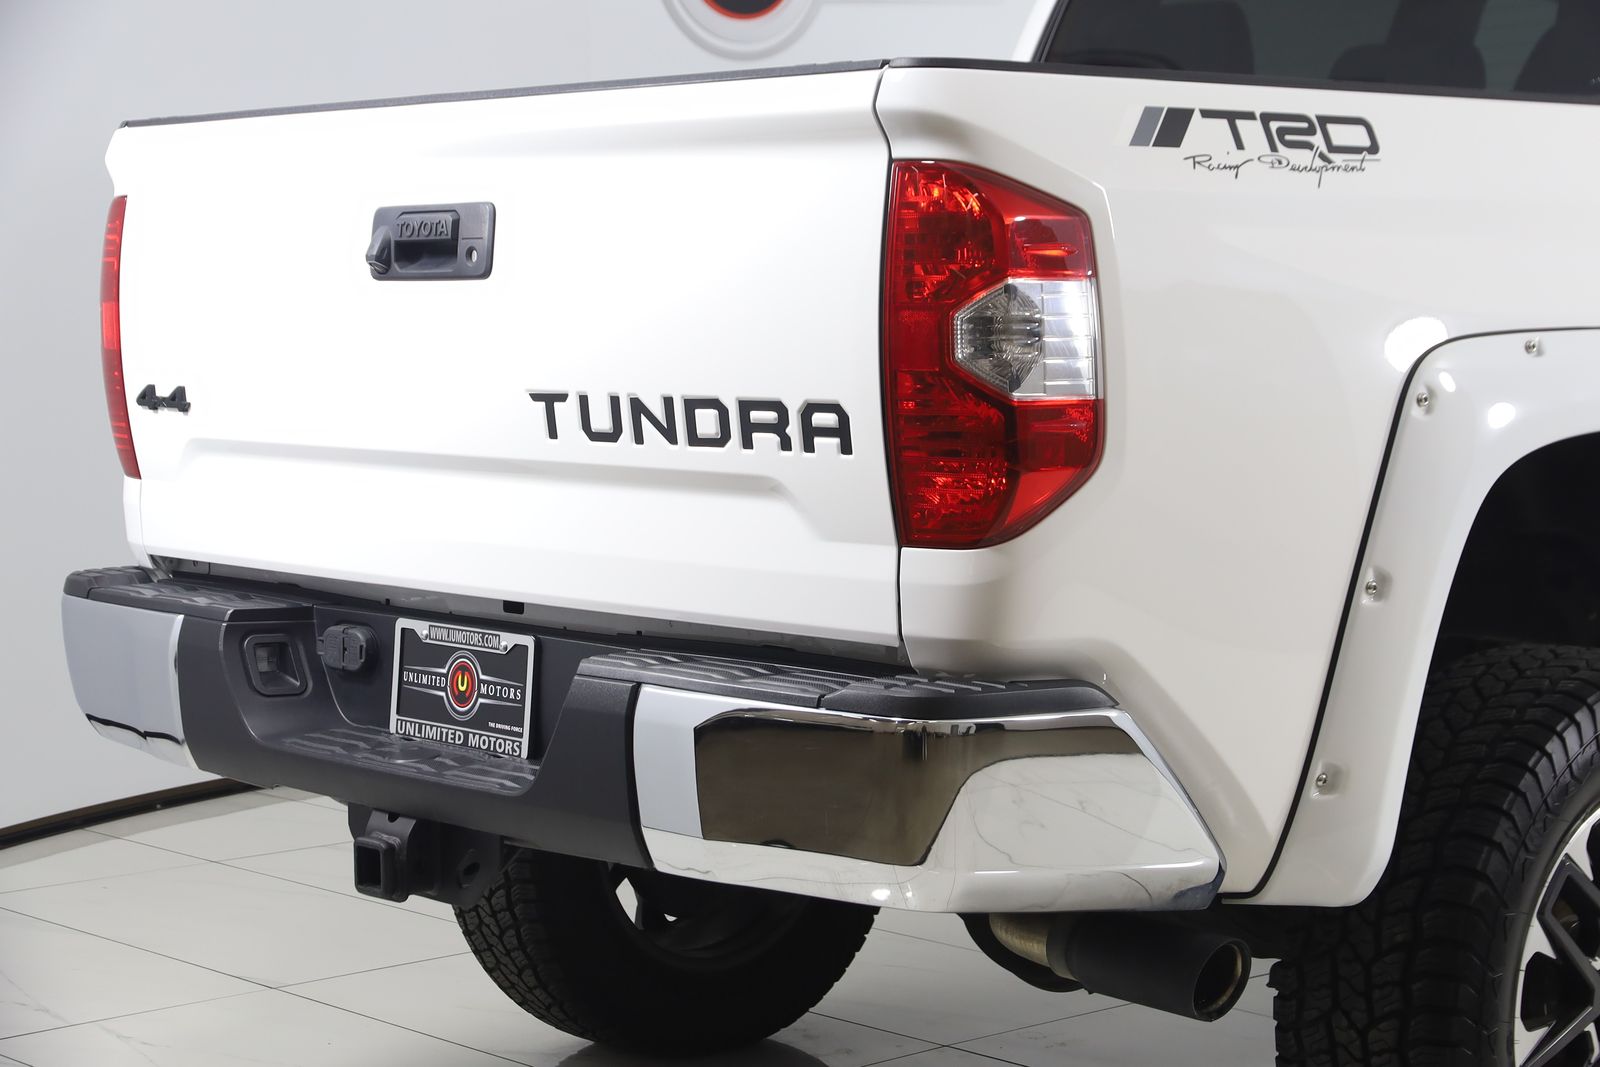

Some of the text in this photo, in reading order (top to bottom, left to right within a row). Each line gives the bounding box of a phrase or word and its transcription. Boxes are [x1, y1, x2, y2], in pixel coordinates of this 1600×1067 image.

[1199, 108, 1380, 163] TRD
[1184, 152, 1254, 179] Racing
[396, 219, 448, 238] TOYOTA
[527, 391, 853, 455] TUNDRA
[429, 626, 500, 649] WWW.IUMOTORS.COM
[403, 671, 522, 700] UNLIMITED MOTORS
[397, 720, 521, 756] UNLIMITED MOTORS
